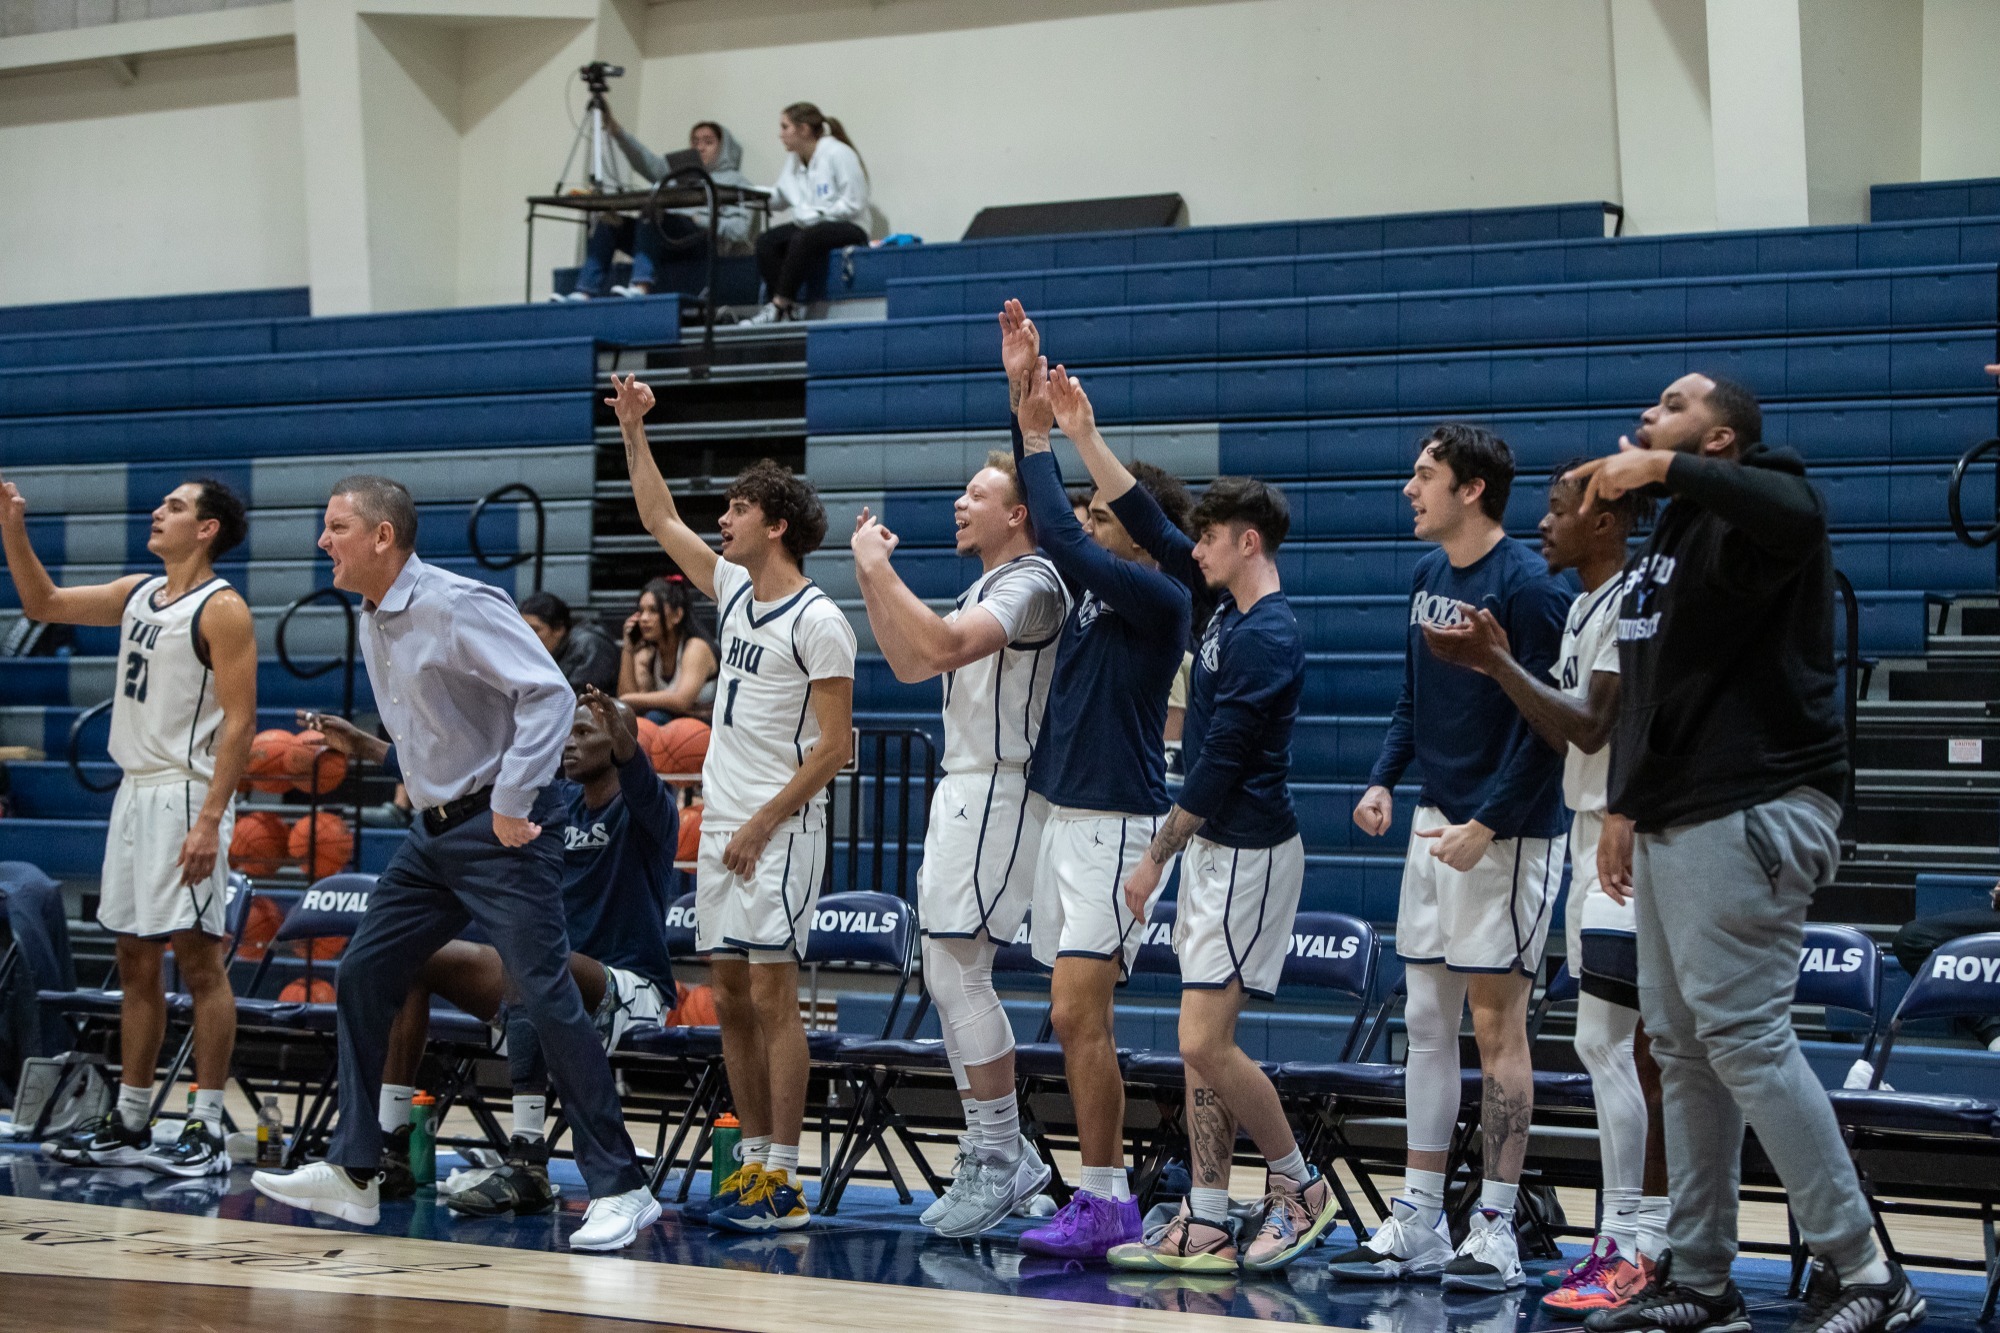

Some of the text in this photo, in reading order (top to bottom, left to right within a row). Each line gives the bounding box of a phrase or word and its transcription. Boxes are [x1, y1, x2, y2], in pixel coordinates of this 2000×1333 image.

[1410, 590, 1472, 627] ROYA
[725, 636, 764, 675] HIU
[124, 651, 148, 703] 21
[723, 678, 741, 728] 1
[302, 890, 369, 912] ROYAL
[1286, 934, 1360, 959] YALS
[1932, 955, 2000, 983] ROY
